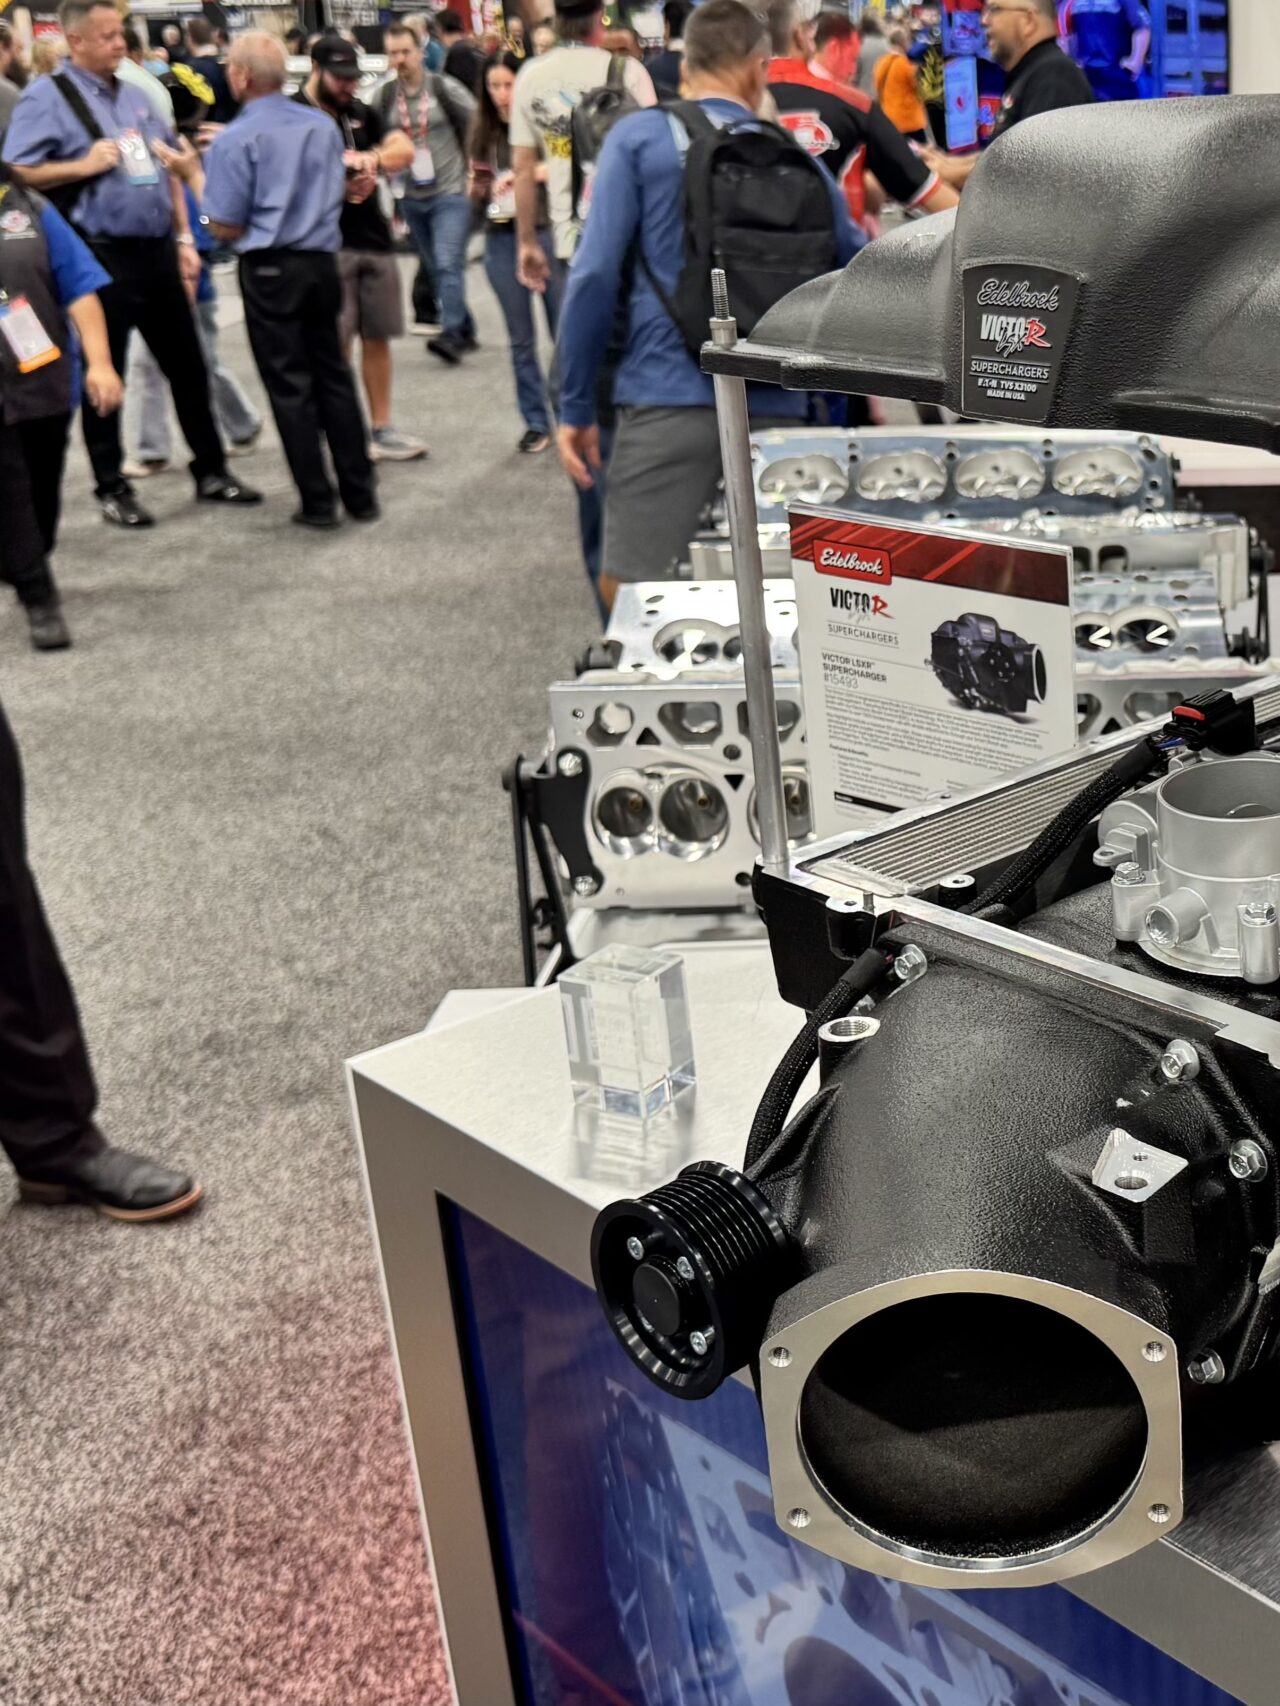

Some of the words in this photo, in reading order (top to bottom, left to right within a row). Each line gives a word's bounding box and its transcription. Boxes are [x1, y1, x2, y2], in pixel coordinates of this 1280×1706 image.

[977, 279, 1060, 311] Edelbrock
[980, 313, 1052, 348] VICTOR
[970, 361, 1050, 379] SUPERCHARGERS
[986, 389, 1005, 398] MADE
[1012, 392, 1026, 400] USA
[820, 548, 884, 576] Edelbrock
[829, 587, 895, 620] VICTOR
[828, 623, 899, 646] SUPERCHARGERS
[822, 651, 851, 667] VICTOR
[822, 662, 887, 682] SUPERCHARGER
